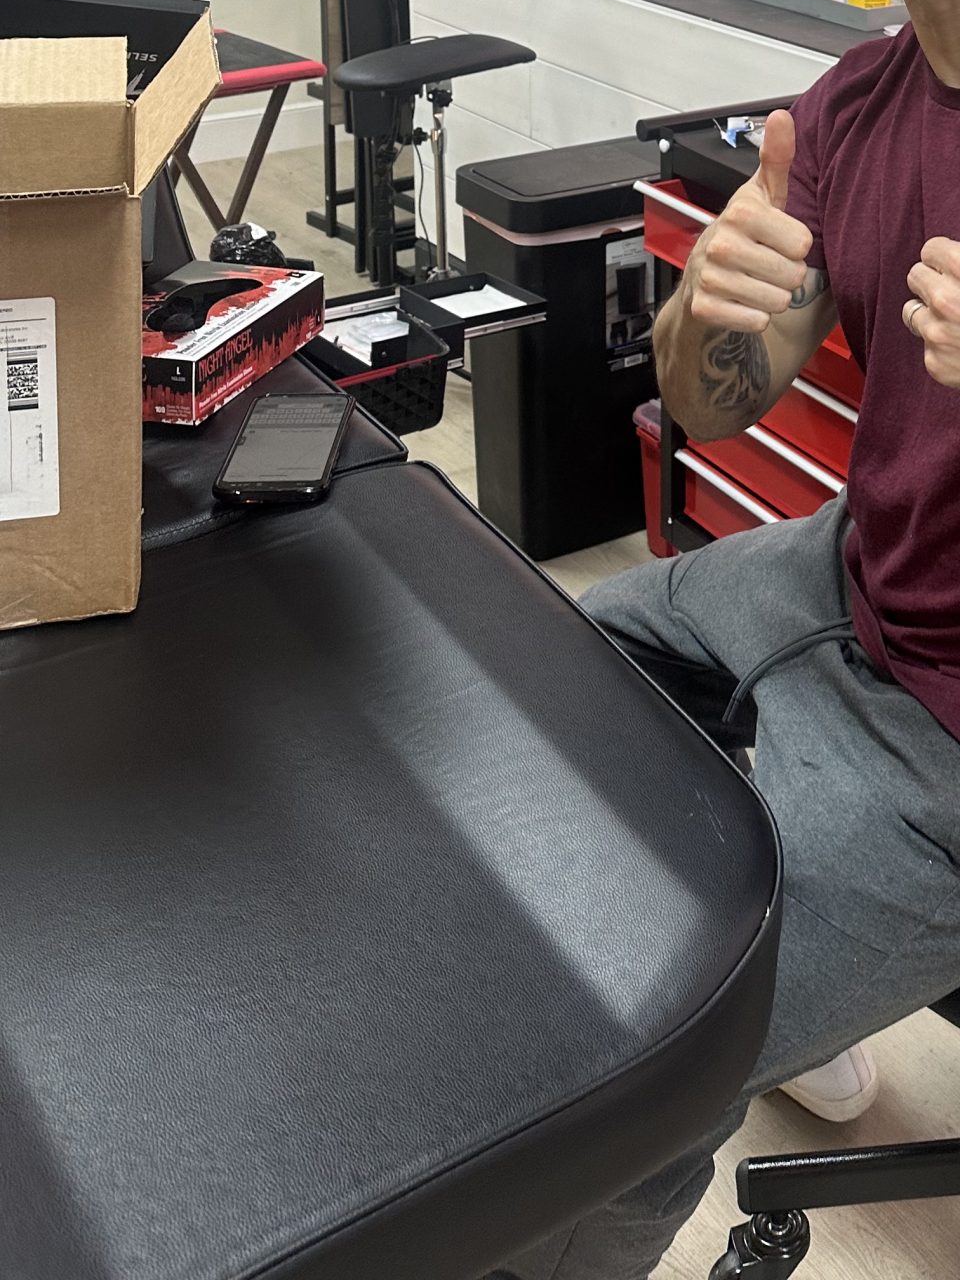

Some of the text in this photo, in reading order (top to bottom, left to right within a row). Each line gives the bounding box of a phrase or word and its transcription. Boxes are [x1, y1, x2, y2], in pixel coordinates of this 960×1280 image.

[176, 366, 181, 375] L
[198, 328, 253, 382] NIGHT ANGEL
